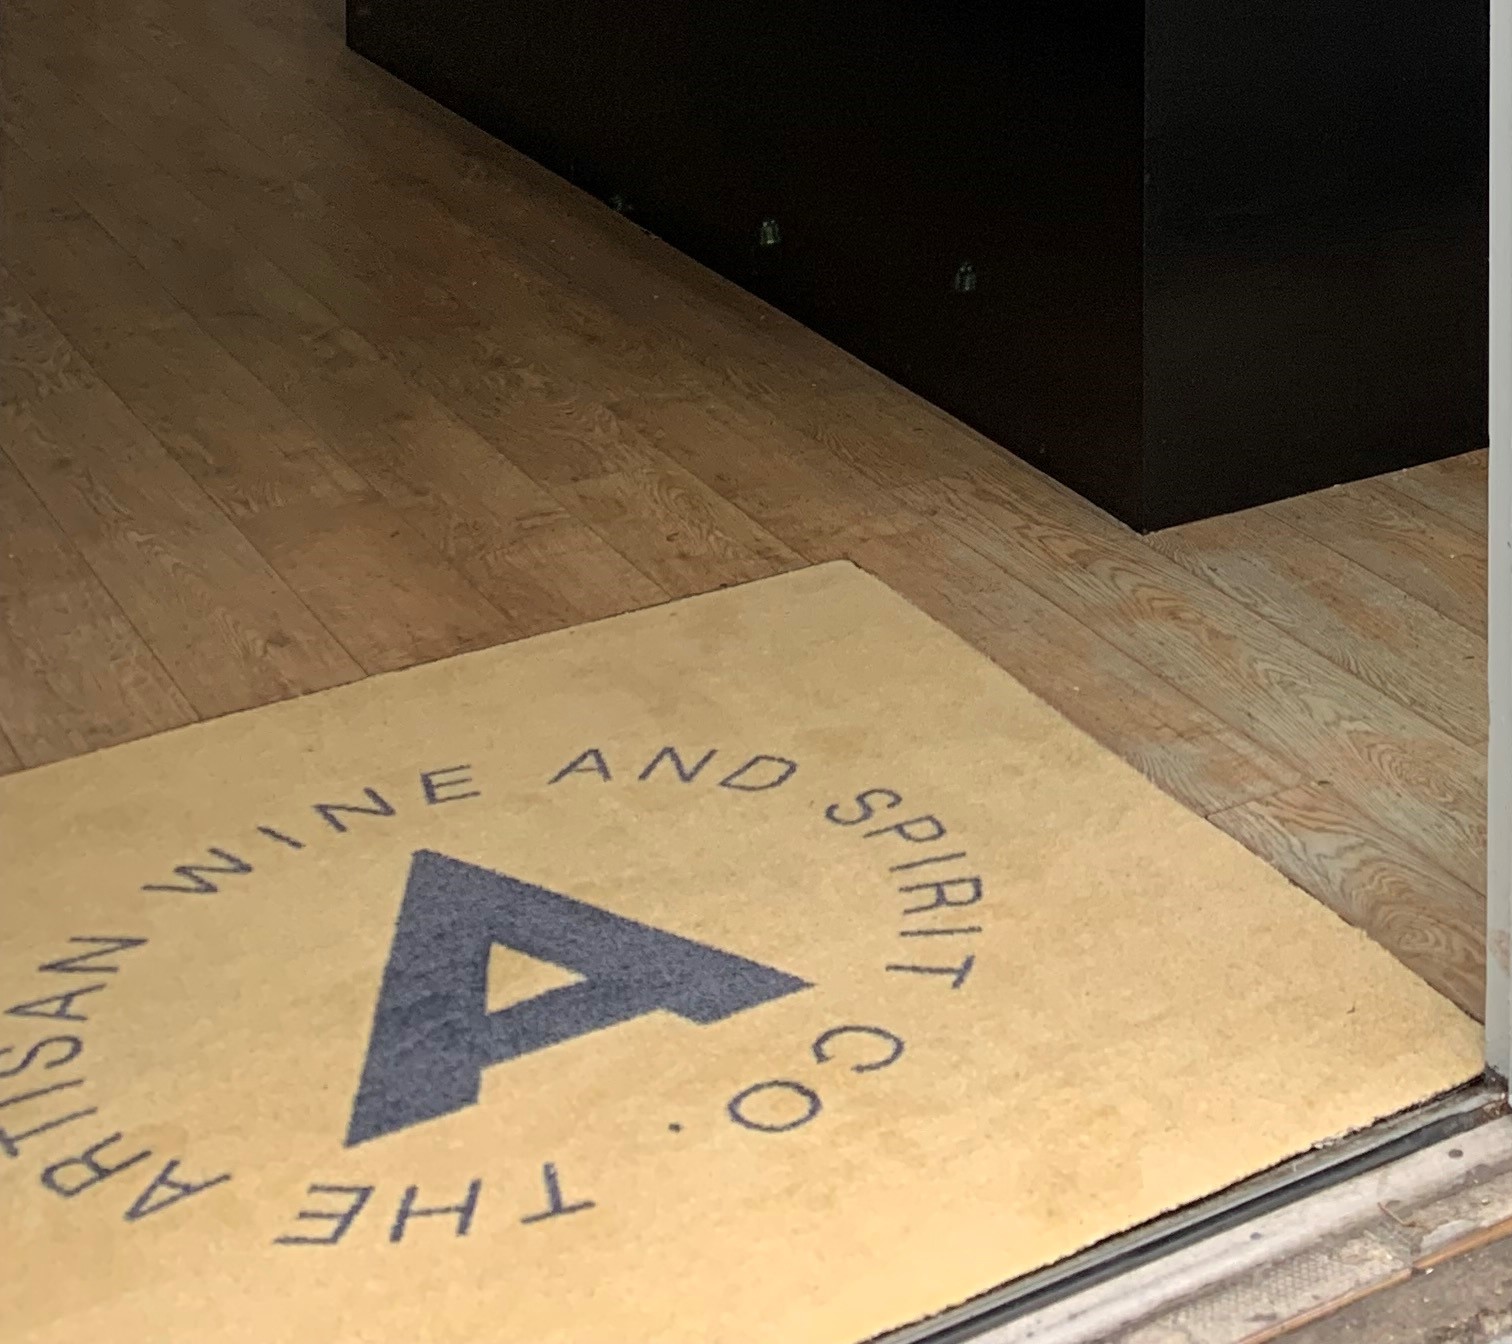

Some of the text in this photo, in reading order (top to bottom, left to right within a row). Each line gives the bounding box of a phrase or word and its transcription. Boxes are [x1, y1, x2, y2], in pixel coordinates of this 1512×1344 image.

[141, 764, 483, 898] WINE
[547, 745, 799, 793] AND
[823, 786, 985, 991] SPIRIT
[0, 934, 233, 1223] ARTISAN
[273, 1161, 596, 1246] THE
